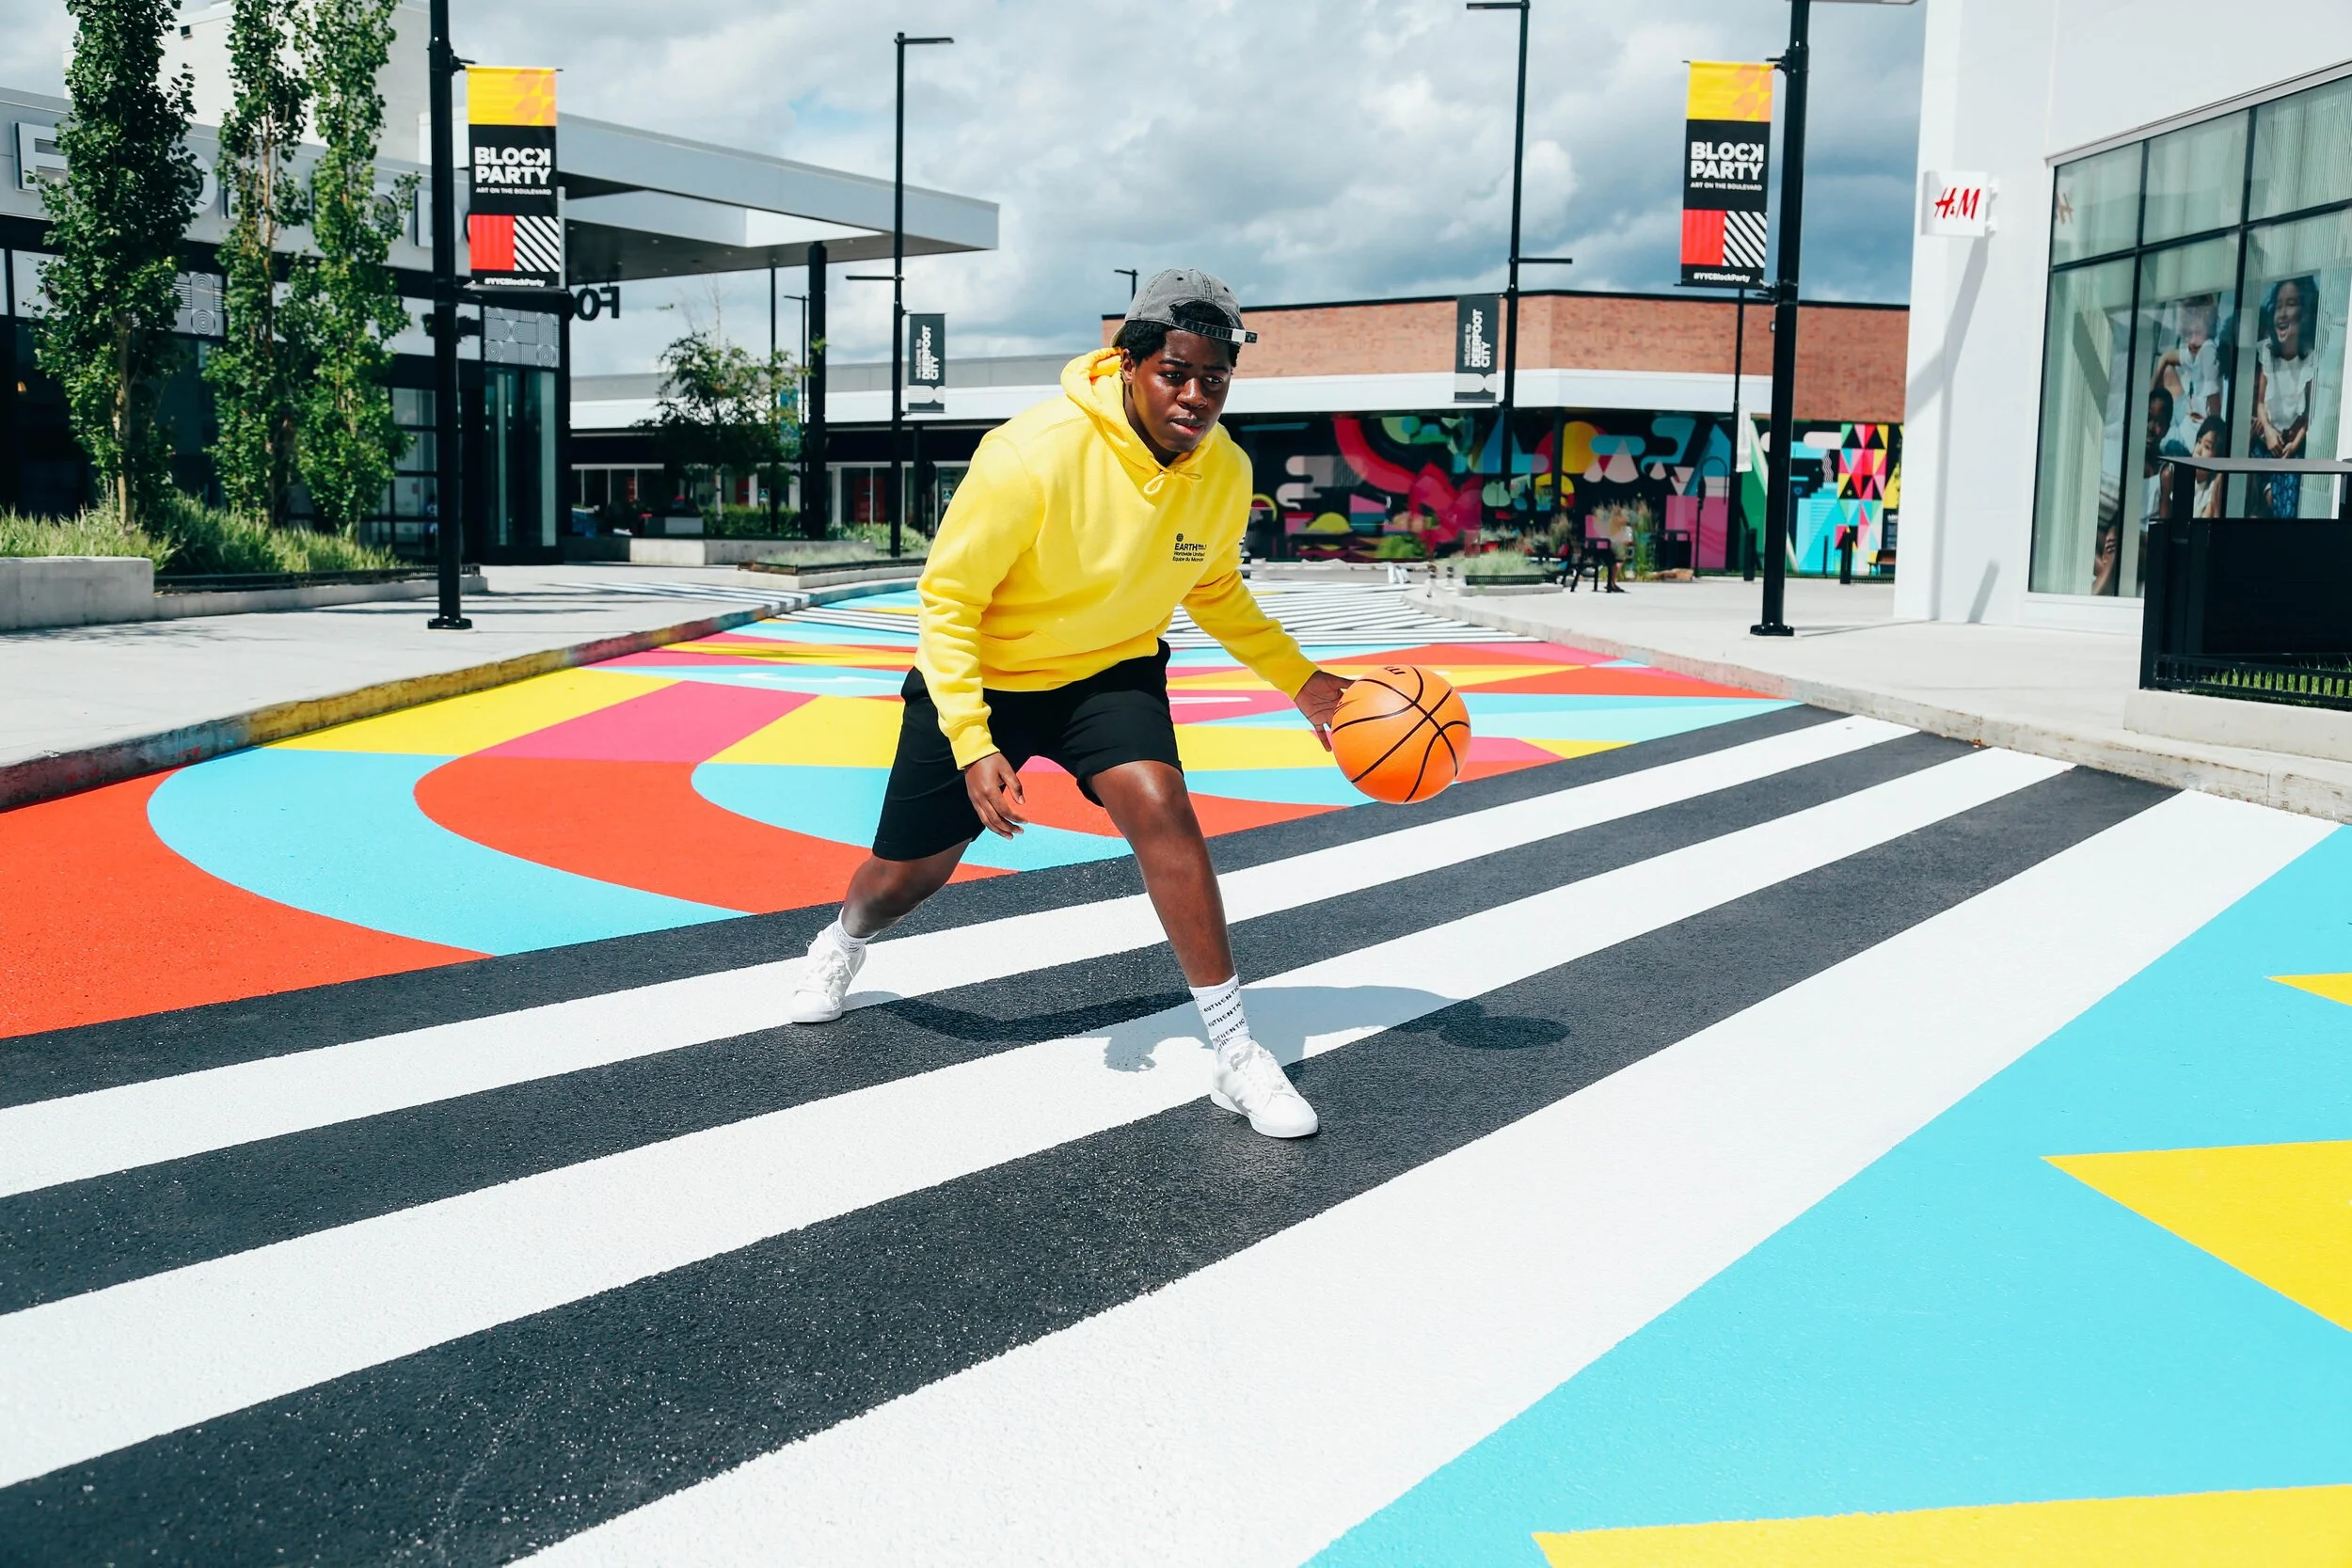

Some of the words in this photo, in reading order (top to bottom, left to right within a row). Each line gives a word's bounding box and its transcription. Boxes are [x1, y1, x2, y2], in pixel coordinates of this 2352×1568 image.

[474, 147, 551, 166] BLOCK
[1691, 141, 1764, 162] BLOCK
[474, 166, 551, 184] PARTY
[1691, 160, 1764, 181] PARTY
[1727, 182, 1763, 191] BOULEVARD
[1934, 187, 1980, 220] H&M
[1692, 272, 1751, 283] #YYCBlockParty
[1470, 309, 1483, 368] DEERFOOT
[922, 325, 931, 380] DEERFOOT
[1481, 341, 1491, 368] CITY
[930, 355, 939, 380] CITY
[1174, 543, 1198, 551] EARTH
